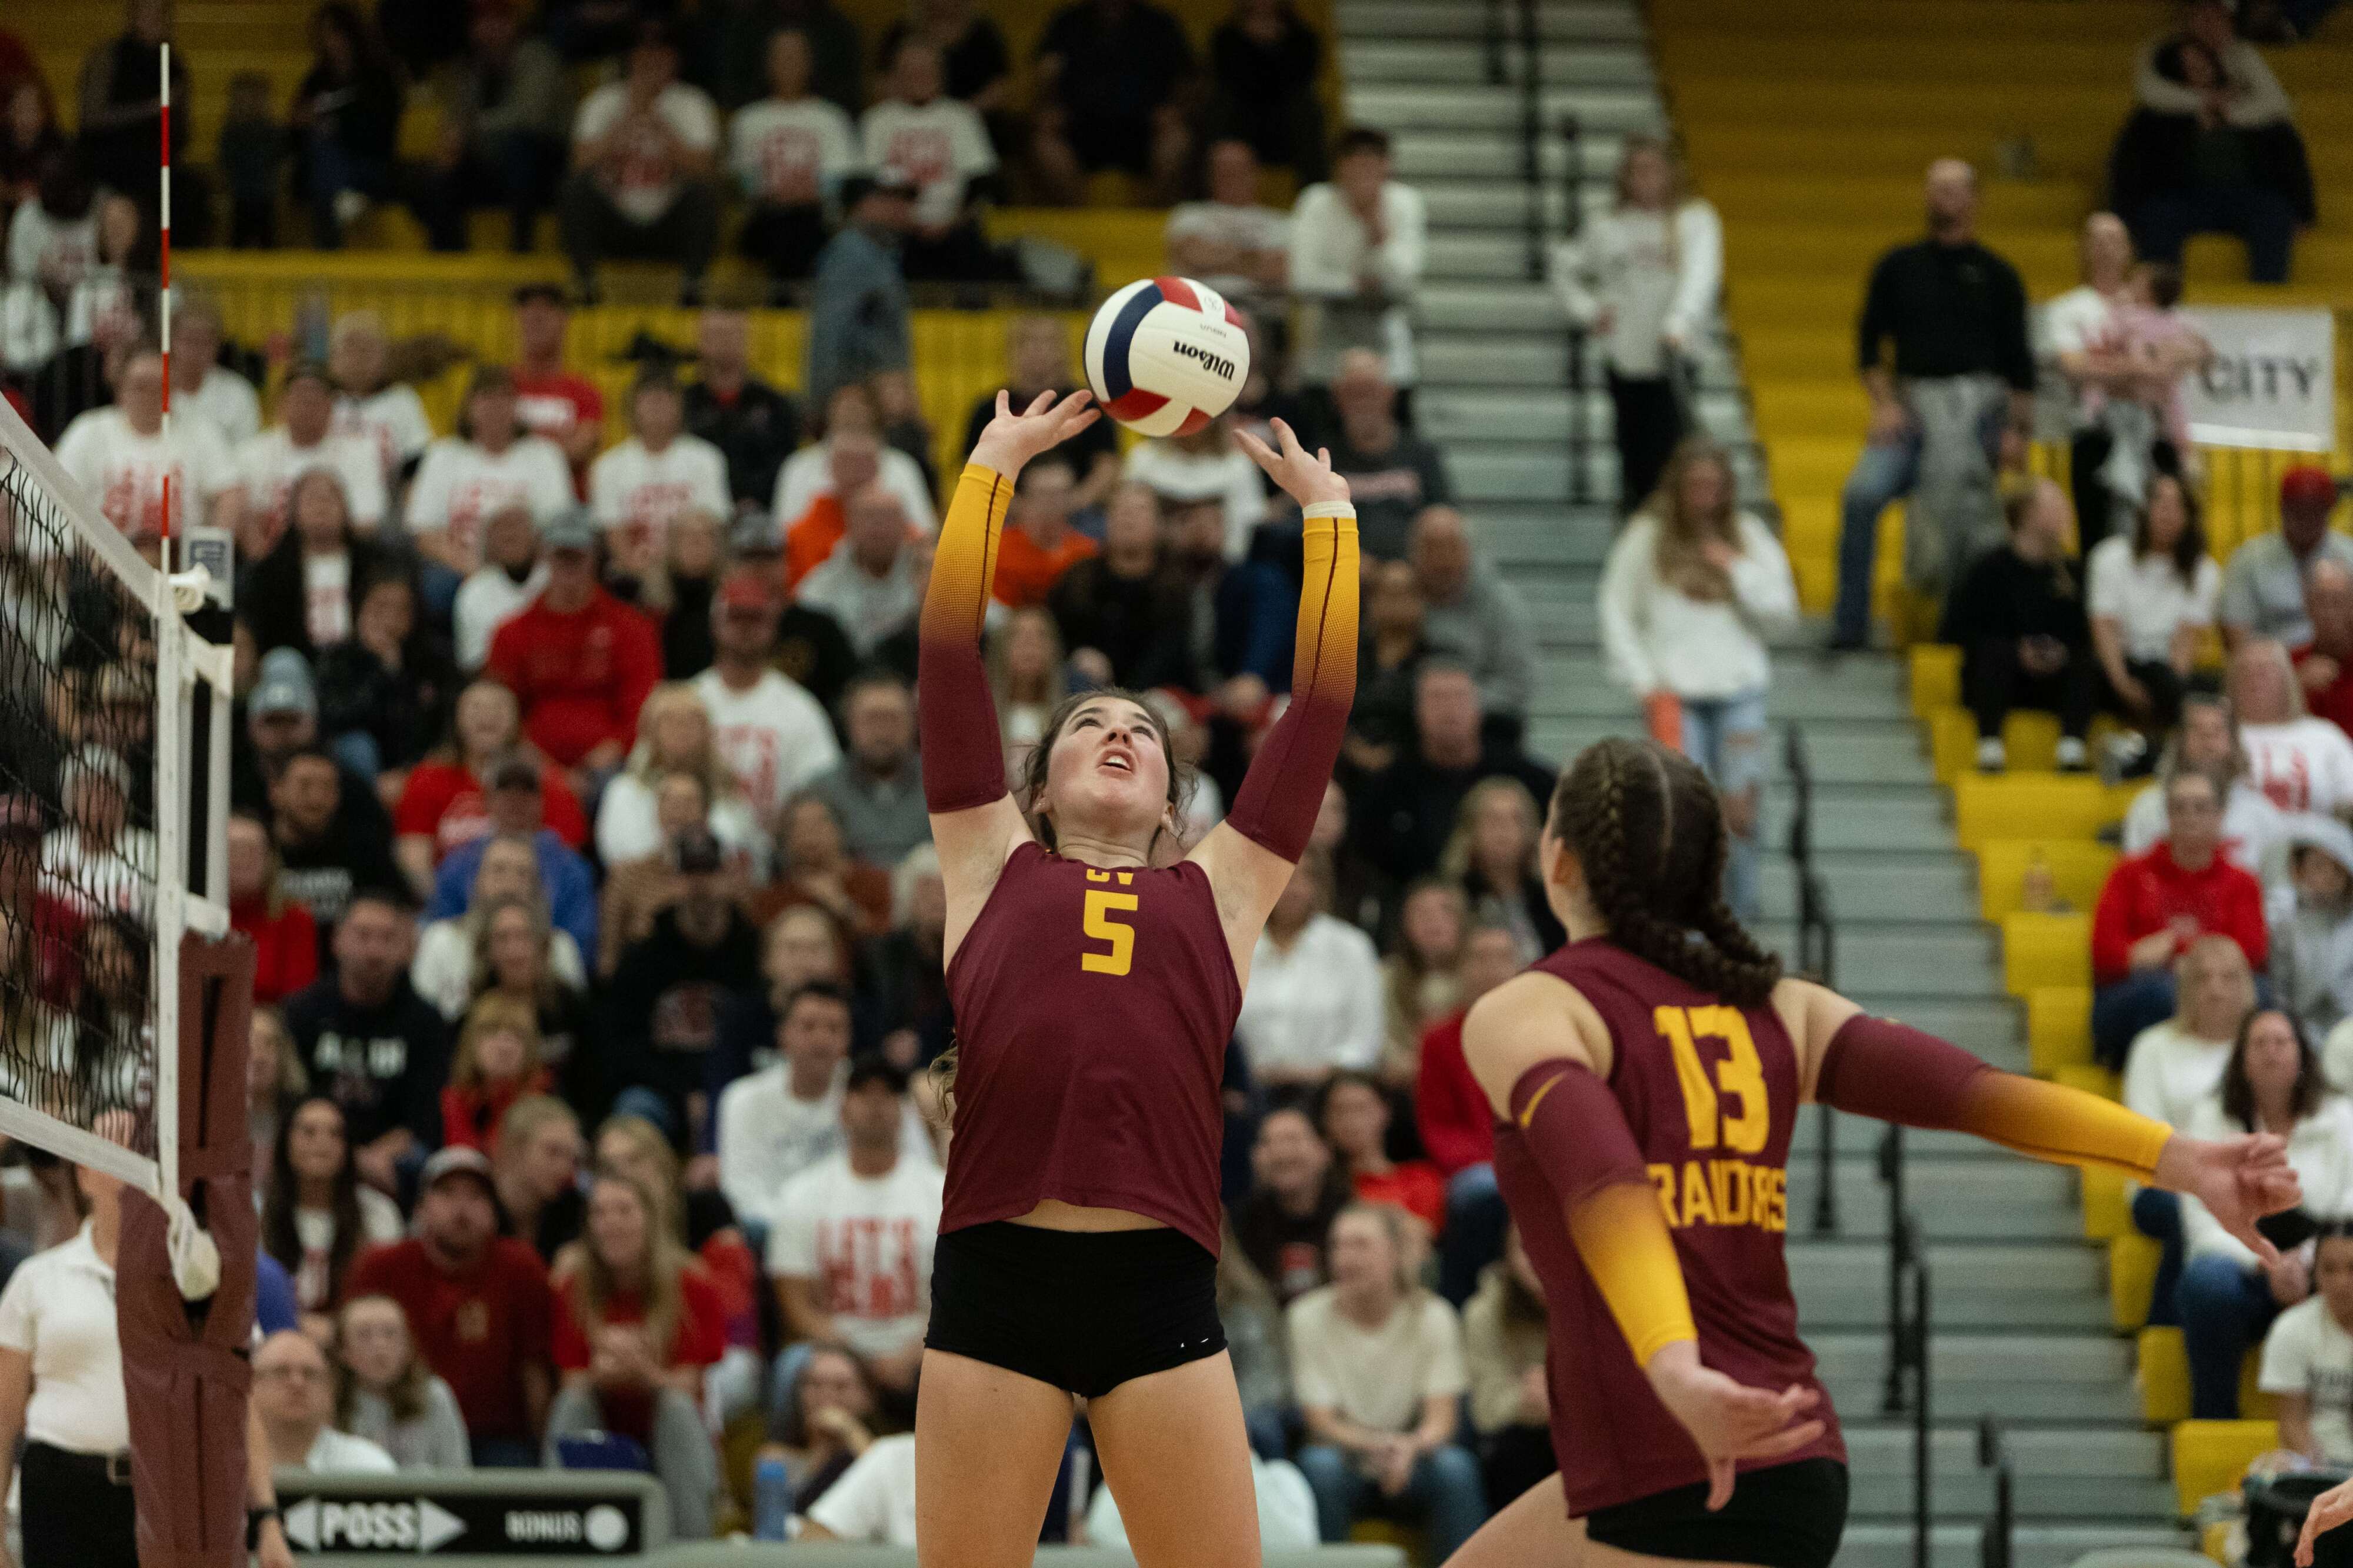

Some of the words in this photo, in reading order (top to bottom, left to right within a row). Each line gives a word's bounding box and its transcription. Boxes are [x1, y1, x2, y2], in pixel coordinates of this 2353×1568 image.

[1174, 340, 1235, 381] Wilson
[2199, 354, 2321, 403] CITY
[1081, 889, 1139, 976] 5
[1654, 1004, 1770, 1155] 13
[321, 1500, 416, 1548] POSS
